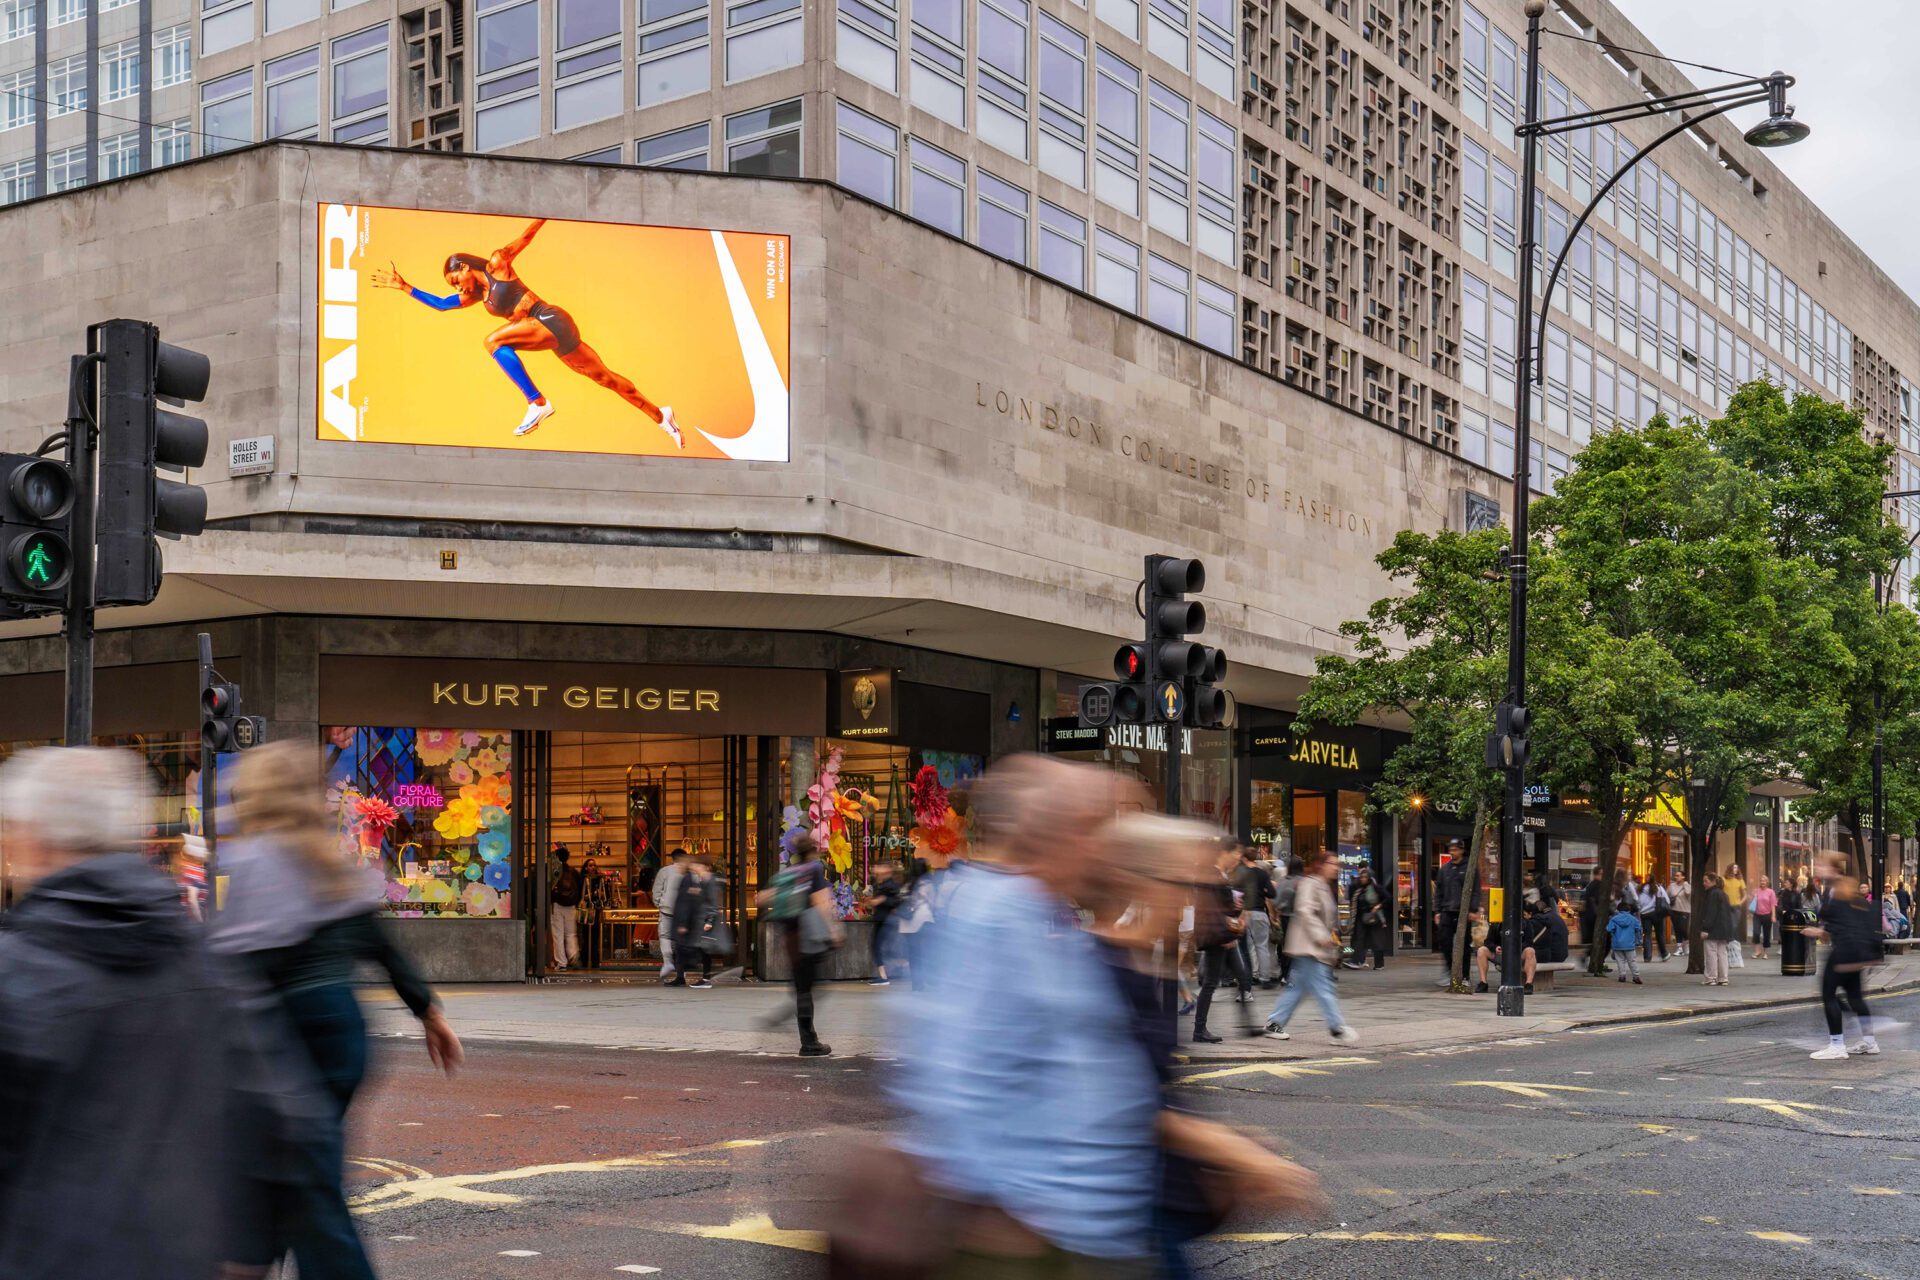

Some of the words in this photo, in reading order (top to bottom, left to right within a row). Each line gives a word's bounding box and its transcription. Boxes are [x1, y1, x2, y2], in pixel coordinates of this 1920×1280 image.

[766, 239, 776, 258] AIR
[766, 260, 776, 276] ON
[766, 278, 776, 299] WIN
[323, 203, 358, 441] AIR
[233, 441, 258, 453] HOLLES
[233, 452, 257, 464] STREET
[260, 450, 271, 461] W1
[976, 382, 1102, 444] LONDON
[1121, 434, 1231, 490] COLLEGE
[1246, 477, 1270, 502] OF
[1283, 490, 1372, 537] FASHION
[433, 682, 548, 707] KURT
[563, 685, 720, 712] GEIGER
[862, 727, 889, 735] GEIGER
[1056, 730, 1073, 740] STEVE
[1074, 728, 1099, 739] MADDEN
[1109, 724, 1143, 748] STEVE
[1255, 737, 1287, 745] CARVELA
[400, 784, 440, 796] FLORAL
[1524, 785, 1550, 795] SOLE
[393, 795, 444, 807] COUTURE
[1251, 833, 1282, 843] VELA
